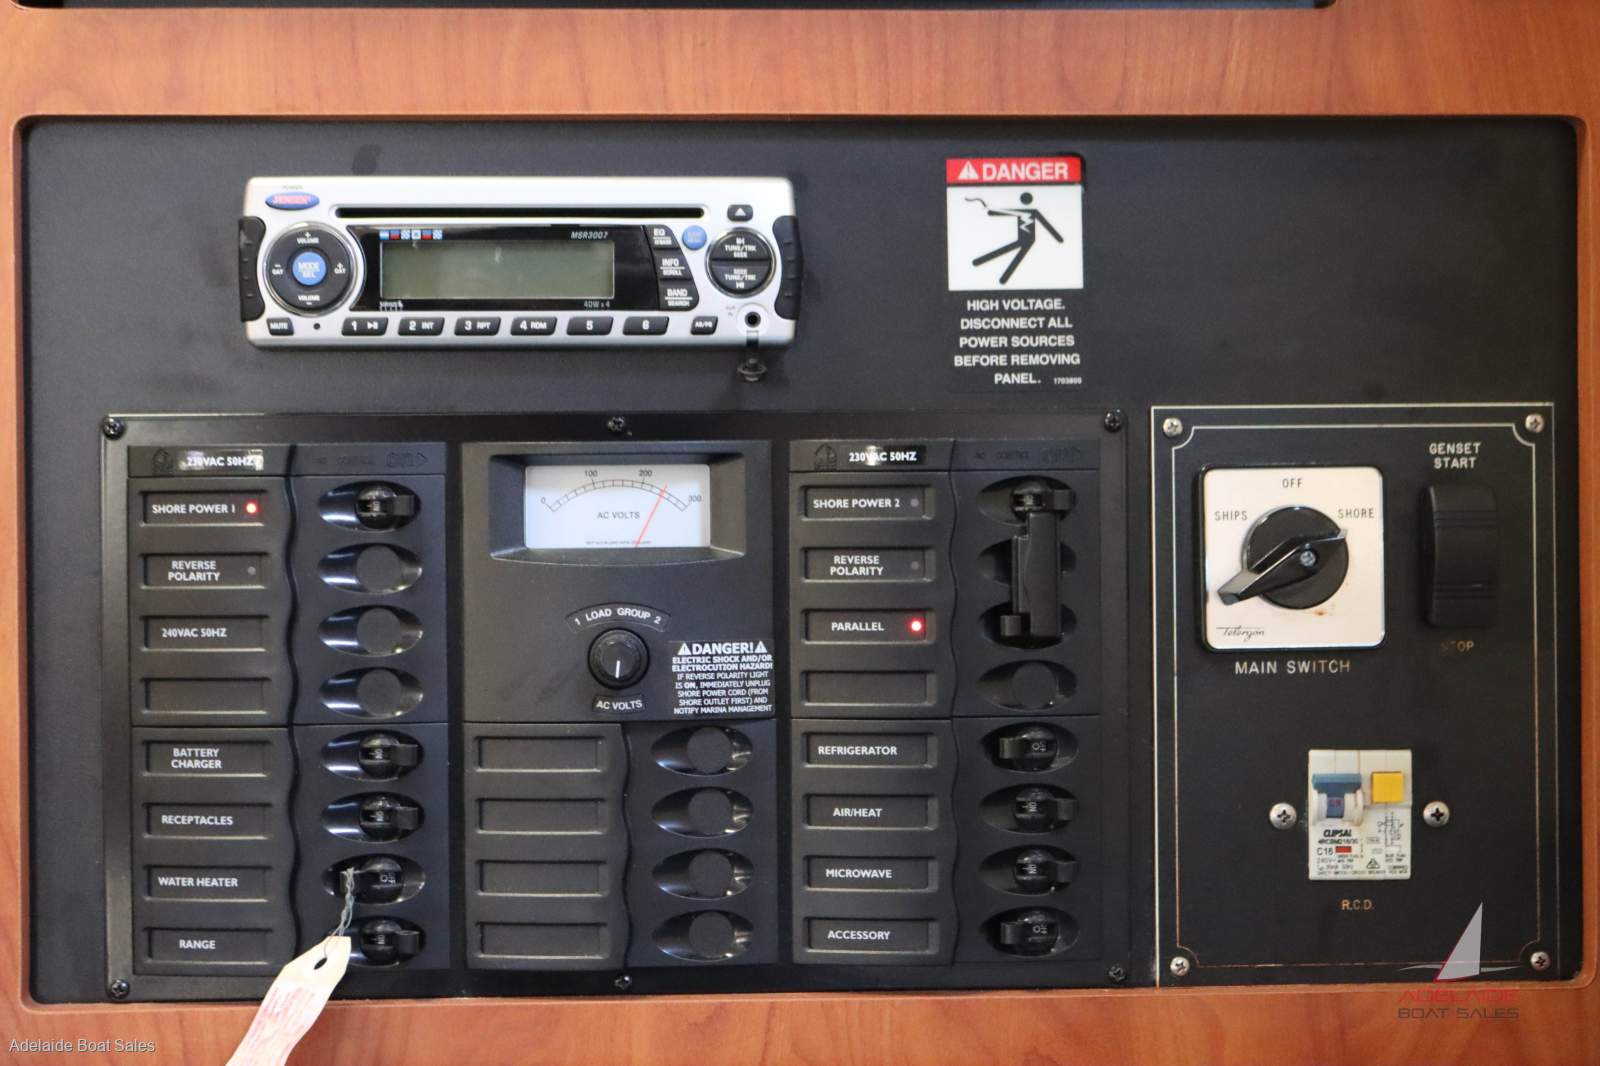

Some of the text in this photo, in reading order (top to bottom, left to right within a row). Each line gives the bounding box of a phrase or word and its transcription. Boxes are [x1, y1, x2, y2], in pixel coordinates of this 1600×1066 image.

[982, 162, 1069, 181] DANGER
[570, 231, 608, 240] MSR3007
[661, 258, 680, 266] INFO
[667, 288, 688, 297] BAND
[667, 300, 691, 308] SEARCH
[967, 299, 1066, 312] HIGH VOLTAGE.
[269, 323, 289, 332] MUTE
[351, 321, 357, 332] 1
[409, 321, 434, 332] 2 INT
[464, 321, 491, 331] 3 RPT
[519, 320, 527, 331] 4
[586, 320, 593, 331] 5
[642, 320, 650, 331] 6
[960, 316, 1073, 330] DISCONNECT ALL
[959, 335, 1075, 349] POWER SOURCES
[954, 353, 1081, 367] BEFORE REMOVING
[994, 373, 1042, 385] PANEL.
[1429, 442, 1481, 455] GENSET
[226, 455, 253, 467] 50HZ
[849, 451, 917, 463] 230VAC 50HZ
[1434, 457, 1477, 470] START
[584, 469, 598, 478] 100
[638, 469, 653, 478] 200
[1282, 478, 1303, 489] OFF
[540, 496, 547, 505] 0
[688, 494, 702, 503] 300
[813, 498, 900, 509] SHORE POWER 2
[152, 504, 187, 514] SHORE
[189, 503, 228, 514] POWER
[1337, 508, 1375, 520] SHORE
[597, 510, 640, 520] AC VOLTS
[1214, 510, 1248, 521] SHIPS
[171, 560, 217, 570] REVERSE
[833, 555, 880, 566] REVERSE
[168, 571, 220, 582] POLARITY
[830, 566, 884, 577] POLARITY
[574, 607, 662, 626] 1 LOAD GROUP 2
[831, 621, 885, 632] PARALLEL
[161, 627, 227, 638] 240VAC 50HZ
[692, 642, 755, 655] DANGER!
[672, 654, 773, 665] ELECTRIC SHOCK AND/OR
[672, 662, 774, 673] ELECTROCUTION HAZARD!
[1235, 660, 1350, 674] MAIN SWITCH
[685, 672, 715, 680] REVERSE
[716, 671, 749, 679] POLARITY
[749, 671, 769, 679] LIGHT
[675, 682, 683, 690] IS
[700, 680, 745, 688] IMMEDIATELY
[745, 679, 771, 687] UNPLUG
[677, 690, 701, 698] SHORE
[702, 689, 727, 697] POWER
[727, 688, 747, 697] CORD
[596, 699, 643, 711] AC VOLTS
[679, 696, 767, 707] SHORE OUTLET FIRST) AND
[673, 704, 773, 715] NOTIFY MARINA MANAGEMENT
[173, 748, 219, 758] BATTERY
[818, 746, 898, 756] REFRIGERATOR
[171, 759, 222, 769] CHARGER
[833, 808, 883, 818] AIR/HEAT
[161, 815, 233, 826] RECEPTACLES
[1323, 829, 1352, 837] CLIPSAL
[825, 868, 893, 879] MICROWAVE
[158, 877, 238, 888] WATER HEATER
[827, 930, 891, 941] ACCESSORY
[179, 939, 216, 949] RANGE
